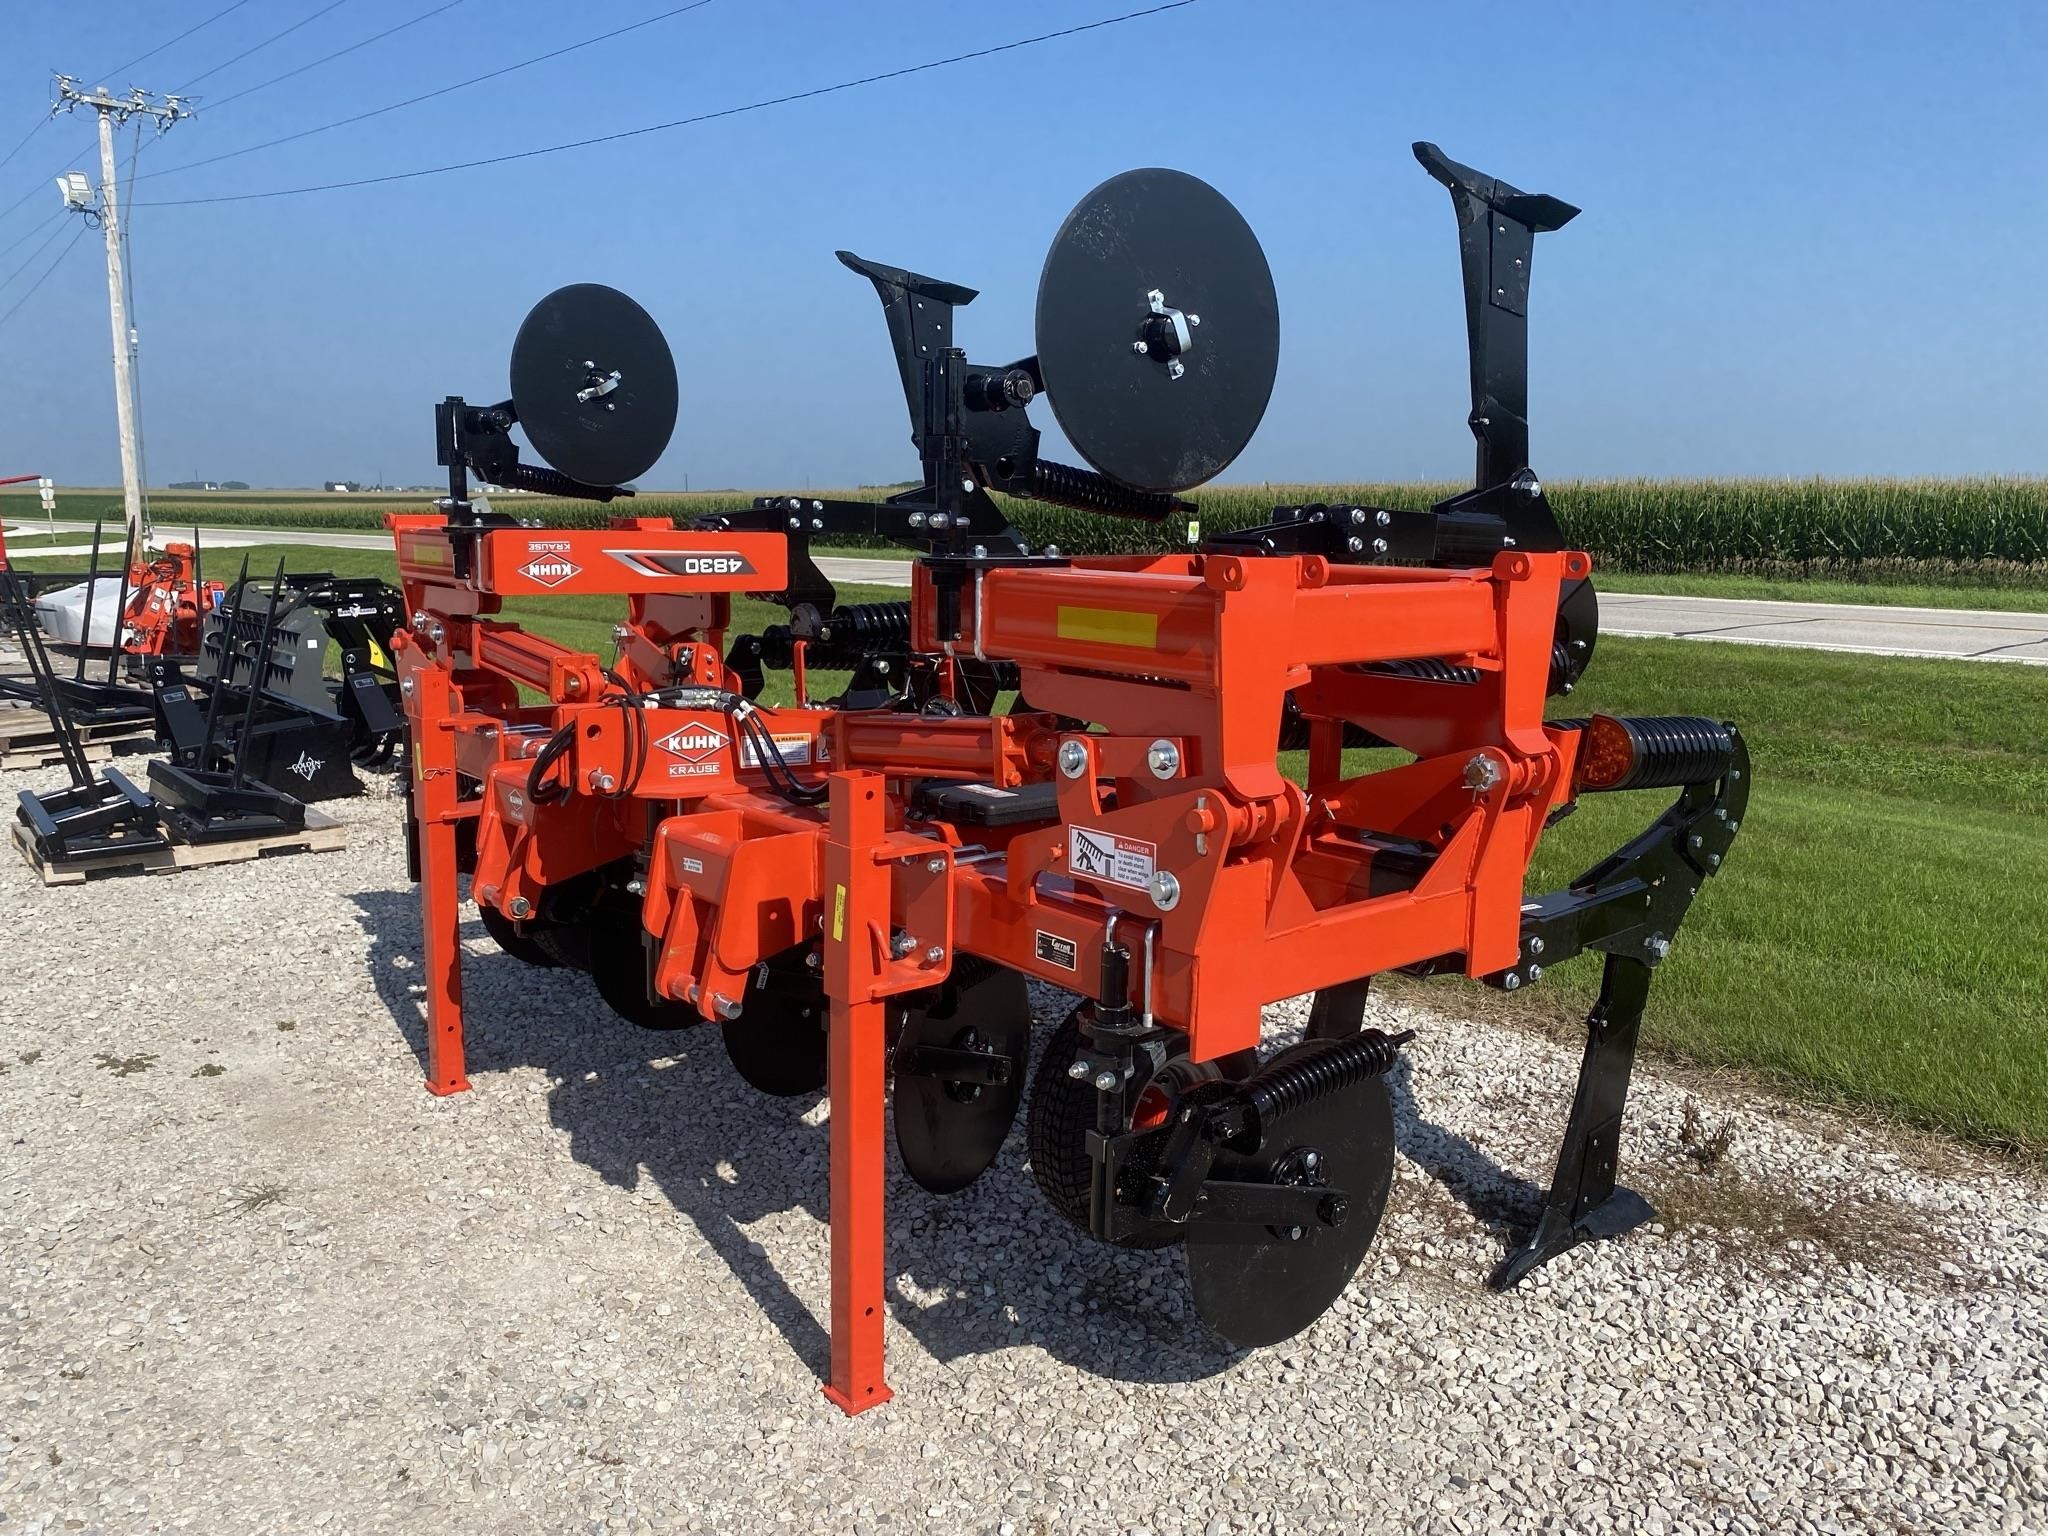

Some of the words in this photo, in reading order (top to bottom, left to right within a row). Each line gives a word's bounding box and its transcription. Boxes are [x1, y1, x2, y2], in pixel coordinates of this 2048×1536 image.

[528, 543, 570, 551] KRAUSE
[529, 563, 571, 576] KUHN
[685, 558, 742, 573] 4830
[668, 735, 720, 751] KUHN
[669, 765, 719, 775] KRAUSE
[1124, 843, 1149, 854] DANGER
